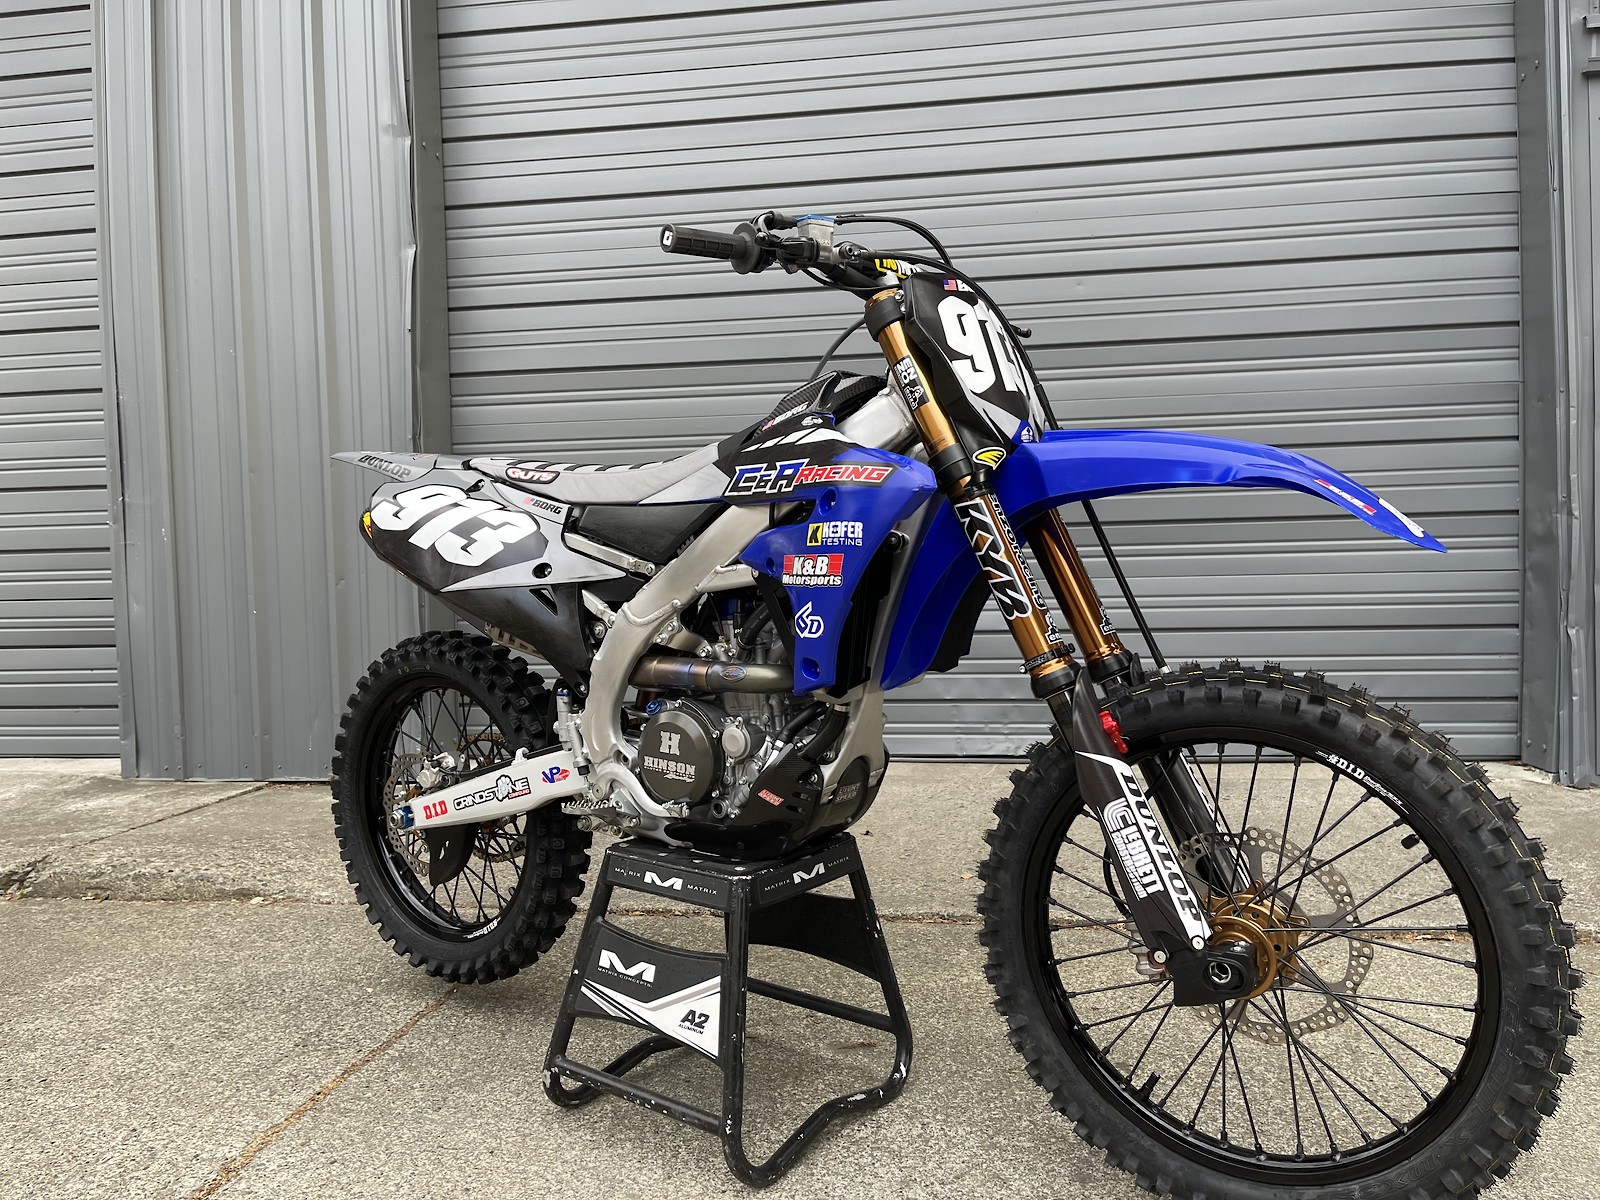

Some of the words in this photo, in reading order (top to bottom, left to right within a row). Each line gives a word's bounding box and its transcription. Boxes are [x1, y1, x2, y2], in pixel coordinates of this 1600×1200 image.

[358, 454, 412, 479] DUNLOP
[506, 467, 556, 482] GUTS
[795, 465, 893, 484] RACING
[532, 500, 563, 515] BORG
[370, 485, 538, 567] 913
[822, 538, 863, 547] TESTING
[793, 556, 829, 576] K&B
[953, 499, 1033, 621] KYB
[782, 573, 842, 587] Motorsports
[659, 730, 681, 756] H
[541, 766, 561, 784] VP
[643, 755, 696, 776] HINSON
[423, 800, 448, 821] D.I.D
[1121, 773, 1201, 922] DUNLOP
[764, 878, 791, 892] MATRIX
[828, 856, 850, 868] MATRIX
[686, 883, 718, 896] MATRIX
[597, 966, 618, 978] MATRIX
[619, 973, 653, 988] CONCEPTS
[678, 1023, 705, 1035] ALUMINUM
[679, 1008, 711, 1030] A2
